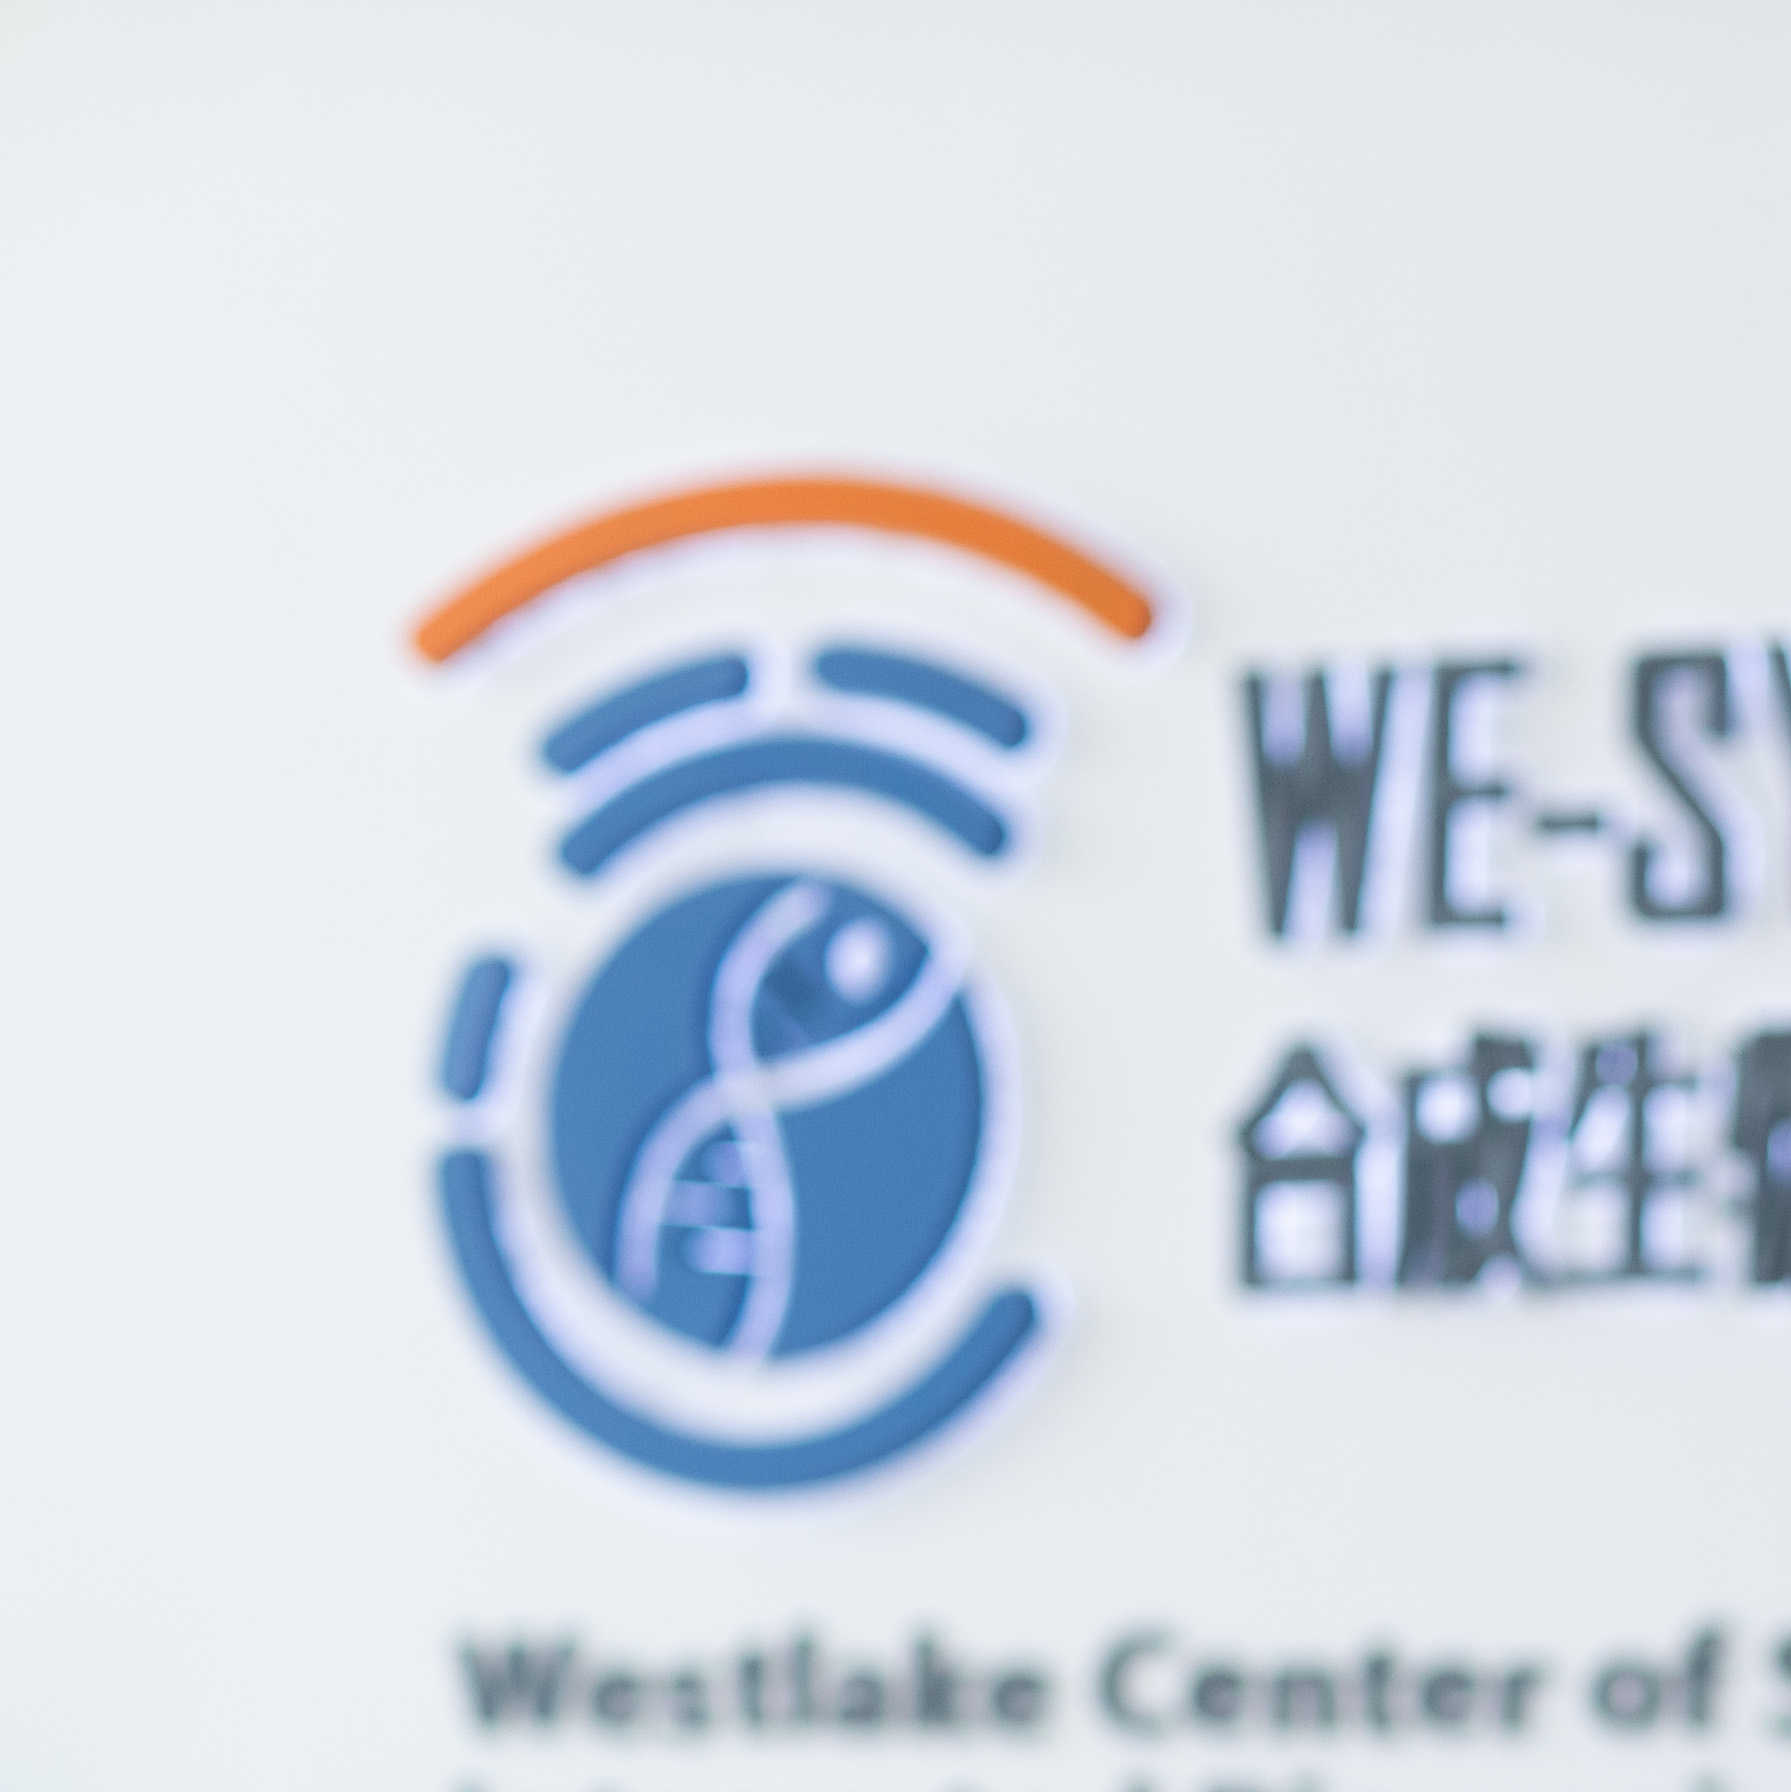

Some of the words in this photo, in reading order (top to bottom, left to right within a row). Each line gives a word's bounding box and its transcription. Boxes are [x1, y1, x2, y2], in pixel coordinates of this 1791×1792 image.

[452, 1628, 1048, 1732] Westlake
[1100, 1632, 1540, 1732] Center
[1596, 1624, 1724, 1730] of
